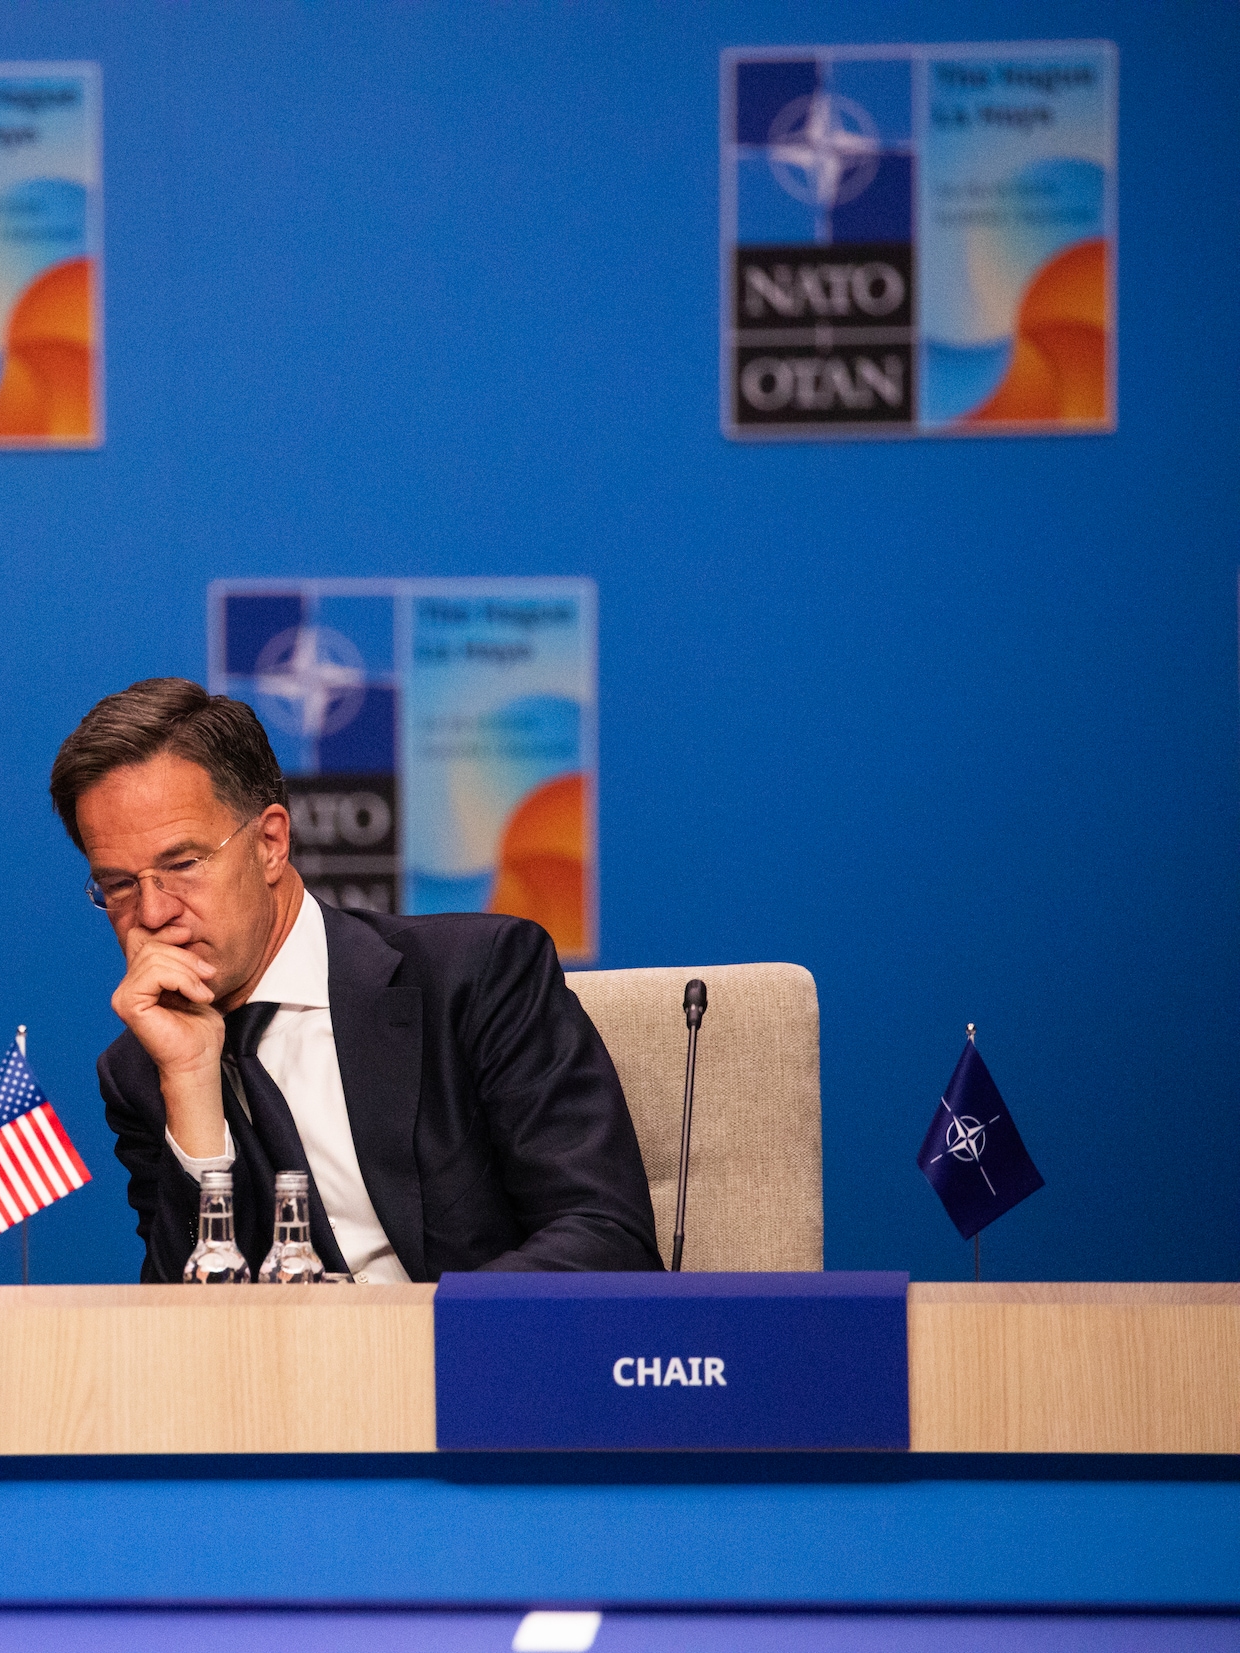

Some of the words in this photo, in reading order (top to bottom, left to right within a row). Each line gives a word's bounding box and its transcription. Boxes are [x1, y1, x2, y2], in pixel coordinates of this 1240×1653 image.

[746, 264, 904, 315] NATO
[741, 357, 902, 408] OTAN
[291, 793, 392, 845] ATO
[612, 1356, 727, 1387] CHAIR
